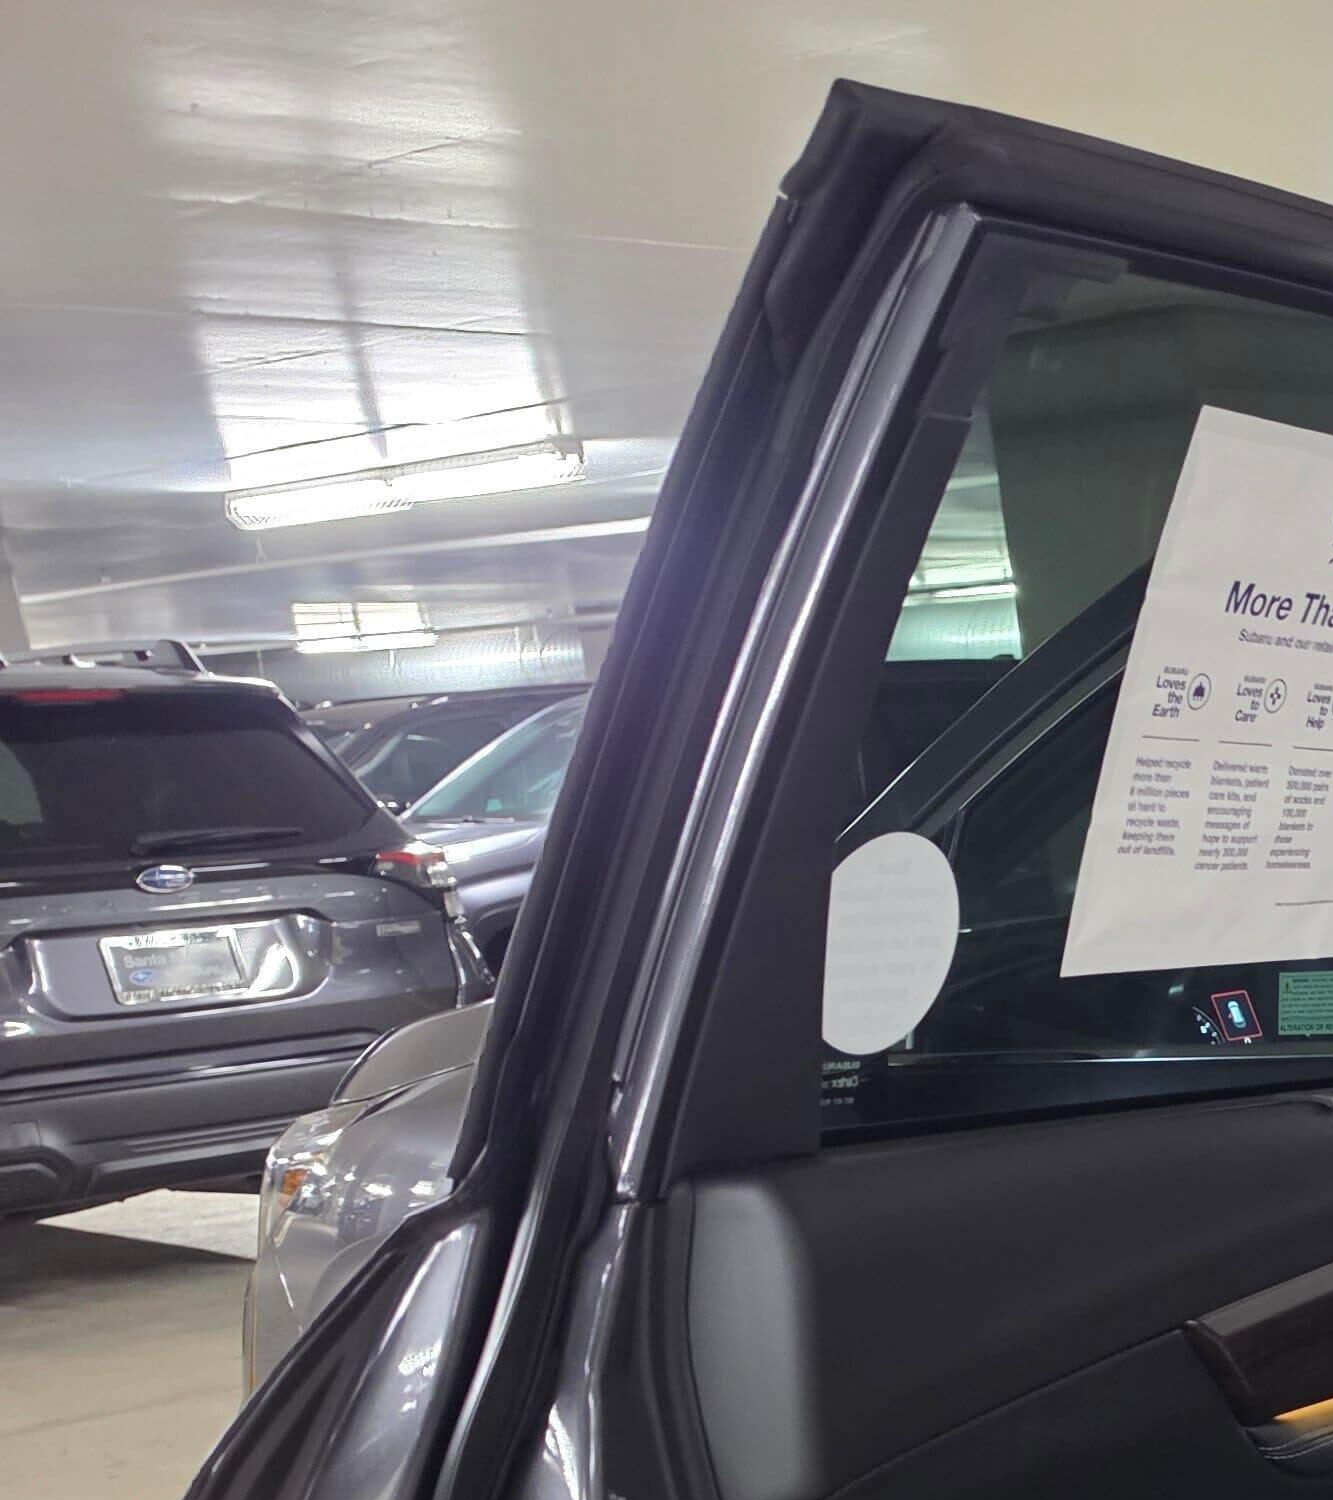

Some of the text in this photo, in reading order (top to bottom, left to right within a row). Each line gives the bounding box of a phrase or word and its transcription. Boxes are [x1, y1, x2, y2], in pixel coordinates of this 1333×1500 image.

[1225, 581, 1292, 621] More
[1238, 628, 1273, 645] Subaru
[1275, 636, 1294, 648] and
[1156, 675, 1186, 691] Loves
[1168, 690, 1183, 704] the
[1236, 684, 1263, 698] Loves
[1306, 691, 1331, 705] Loves
[1152, 703, 1180, 718] Earth
[1250, 700, 1260, 711] to
[1320, 706, 1329, 716] to
[1235, 709, 1257, 724] Care
[1306, 716, 1325, 731] Help
[123, 954, 166, 969] Santa
[1280, 1023, 1314, 1032] ALTERATION
[1316, 1023, 1325, 1031] OR
